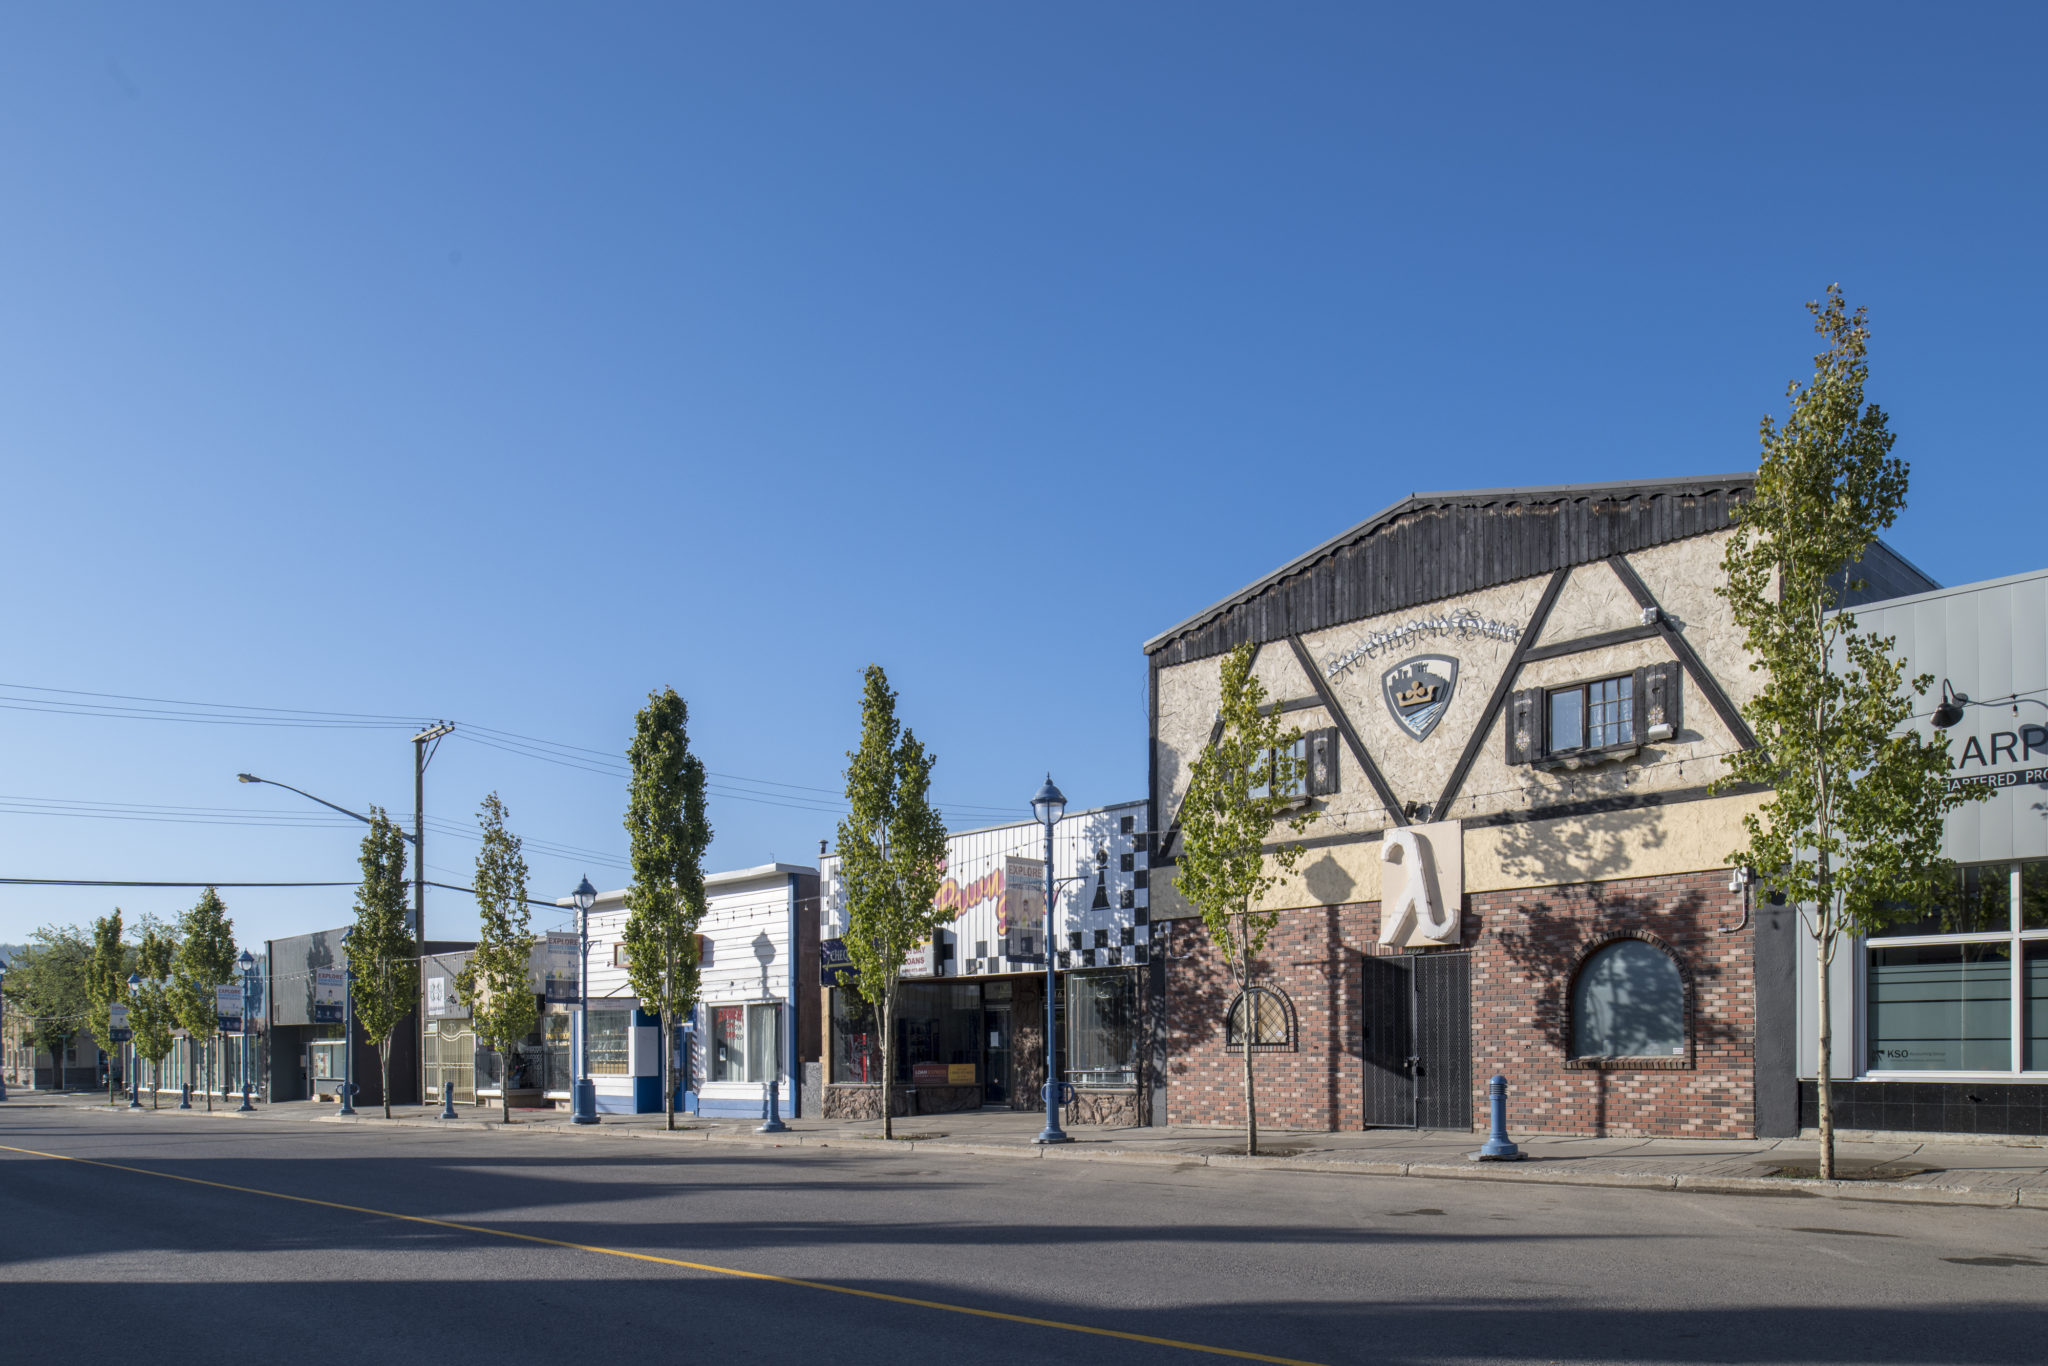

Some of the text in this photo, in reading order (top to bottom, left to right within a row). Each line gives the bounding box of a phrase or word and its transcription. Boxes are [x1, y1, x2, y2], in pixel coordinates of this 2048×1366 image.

[1008, 865, 1042, 878] EXPLORE
[548, 937, 578, 946] EXPLORE
[1887, 1049, 1909, 1058] KSO
